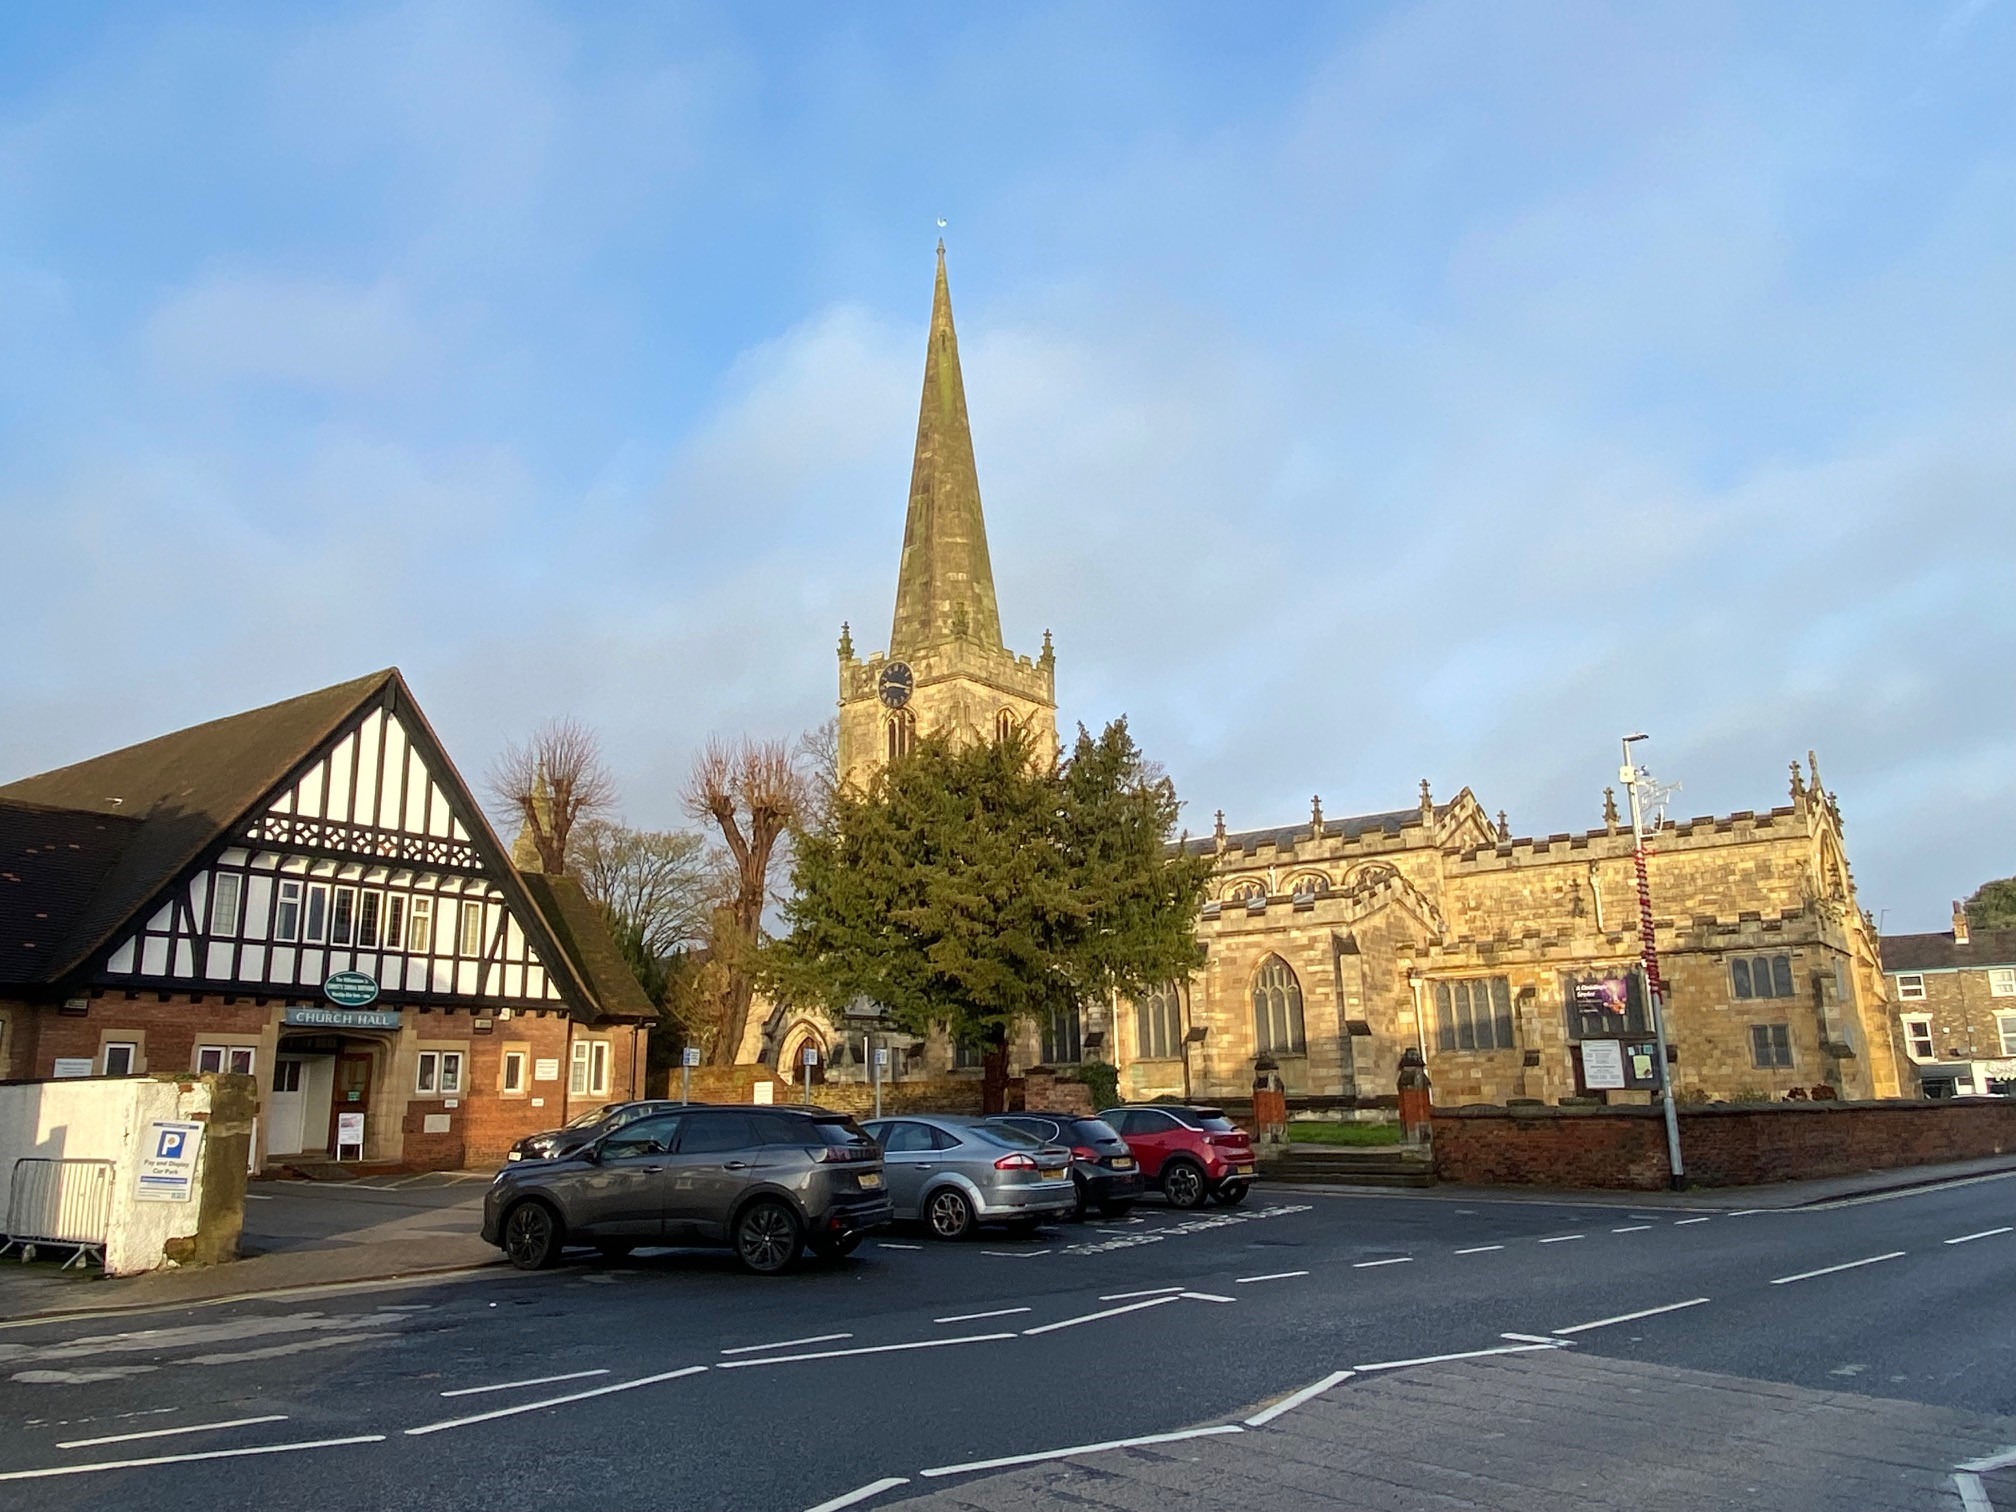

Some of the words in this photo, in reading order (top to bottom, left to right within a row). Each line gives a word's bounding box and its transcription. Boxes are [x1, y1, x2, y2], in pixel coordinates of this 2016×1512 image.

[296, 1012, 352, 1024] CHURCH
[357, 1014, 390, 1026] HALL
[161, 1133, 180, 1155] P
